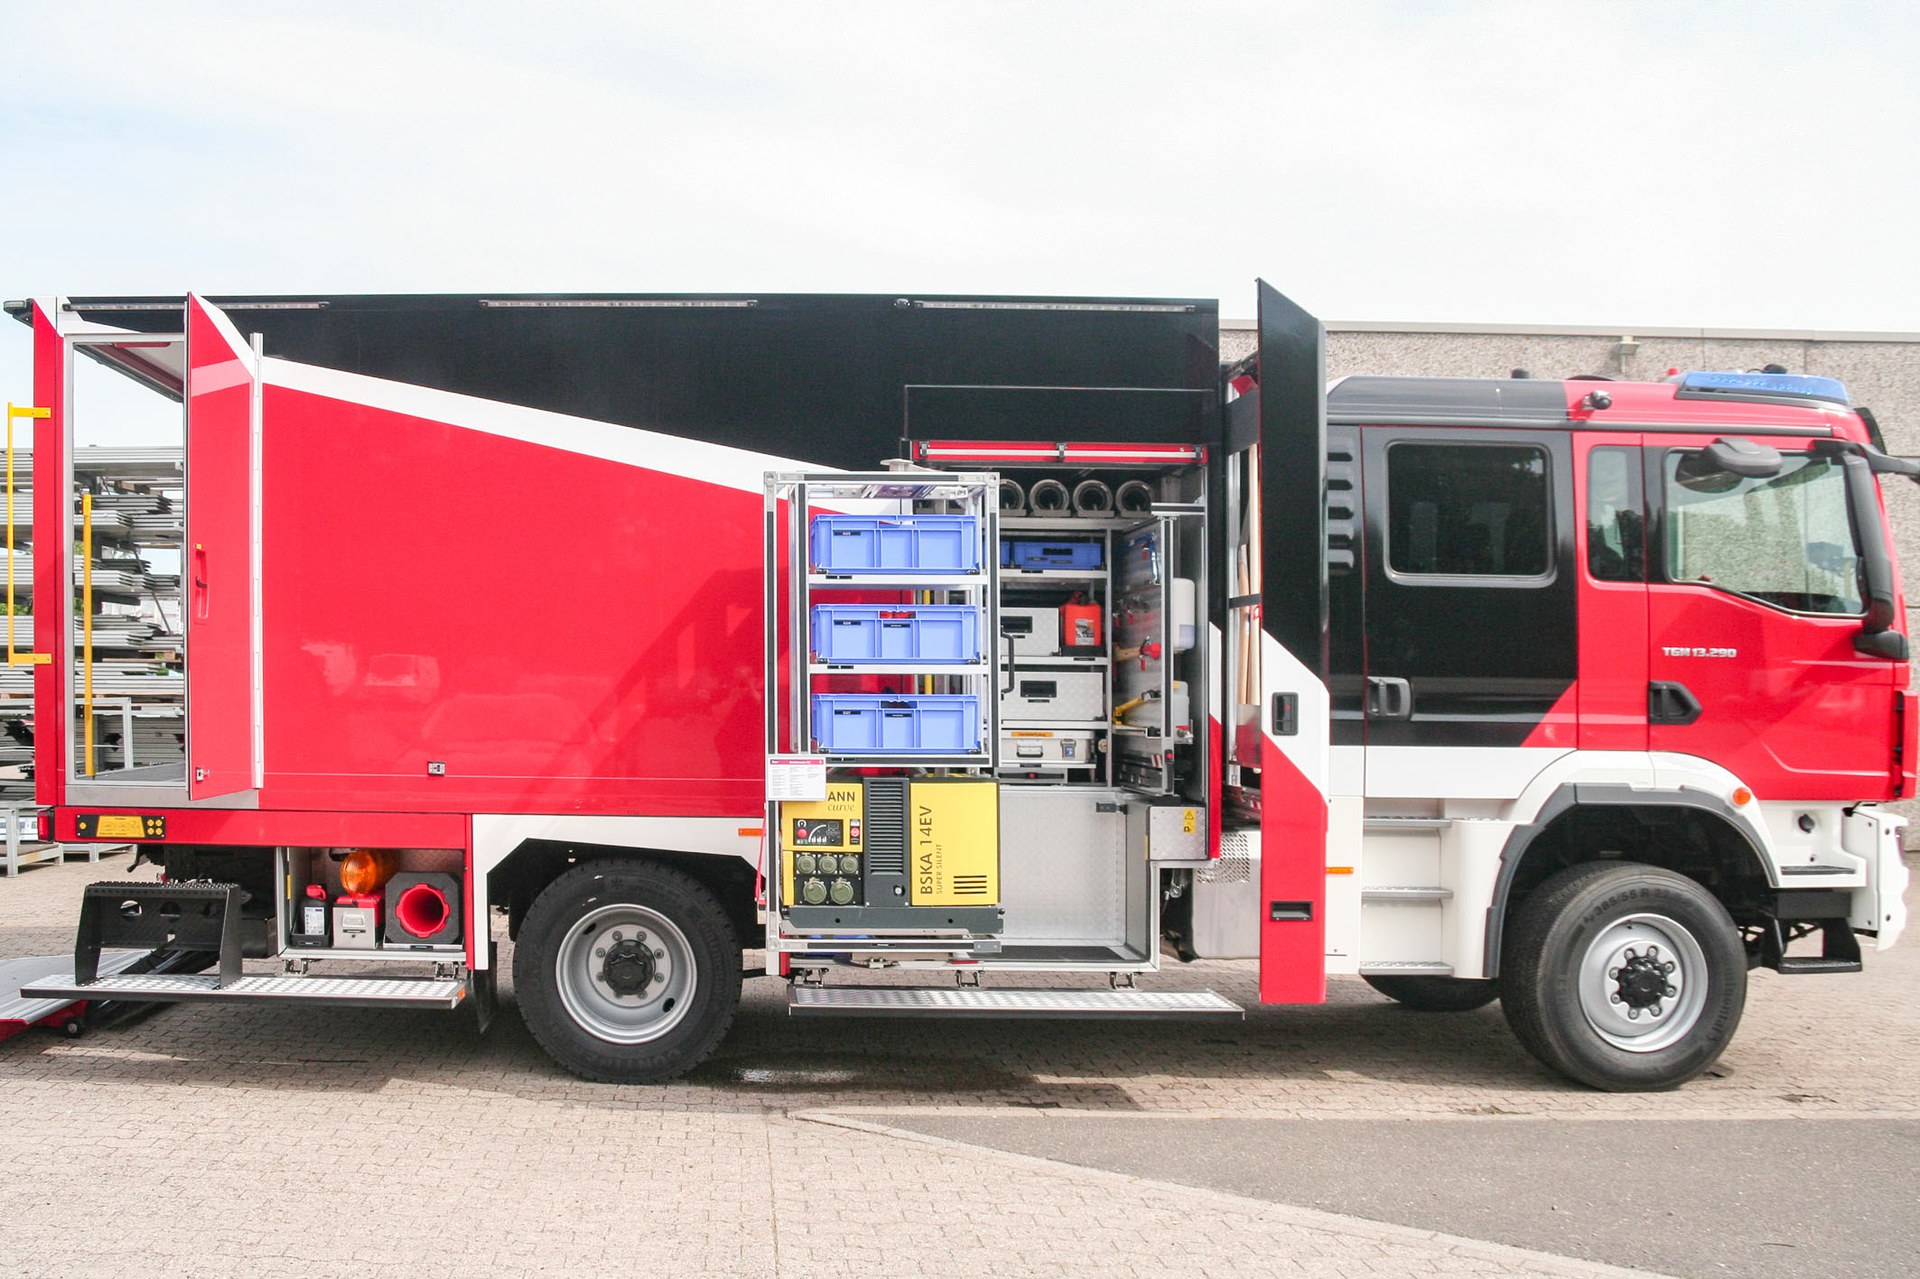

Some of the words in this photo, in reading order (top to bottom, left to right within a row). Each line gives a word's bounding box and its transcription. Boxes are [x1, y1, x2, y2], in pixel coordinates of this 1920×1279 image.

[1662, 647, 1691, 656] TGM
[1692, 647, 1737, 657] 13.290
[919, 805, 932, 845] 14EV
[919, 853, 933, 894] BSKA
